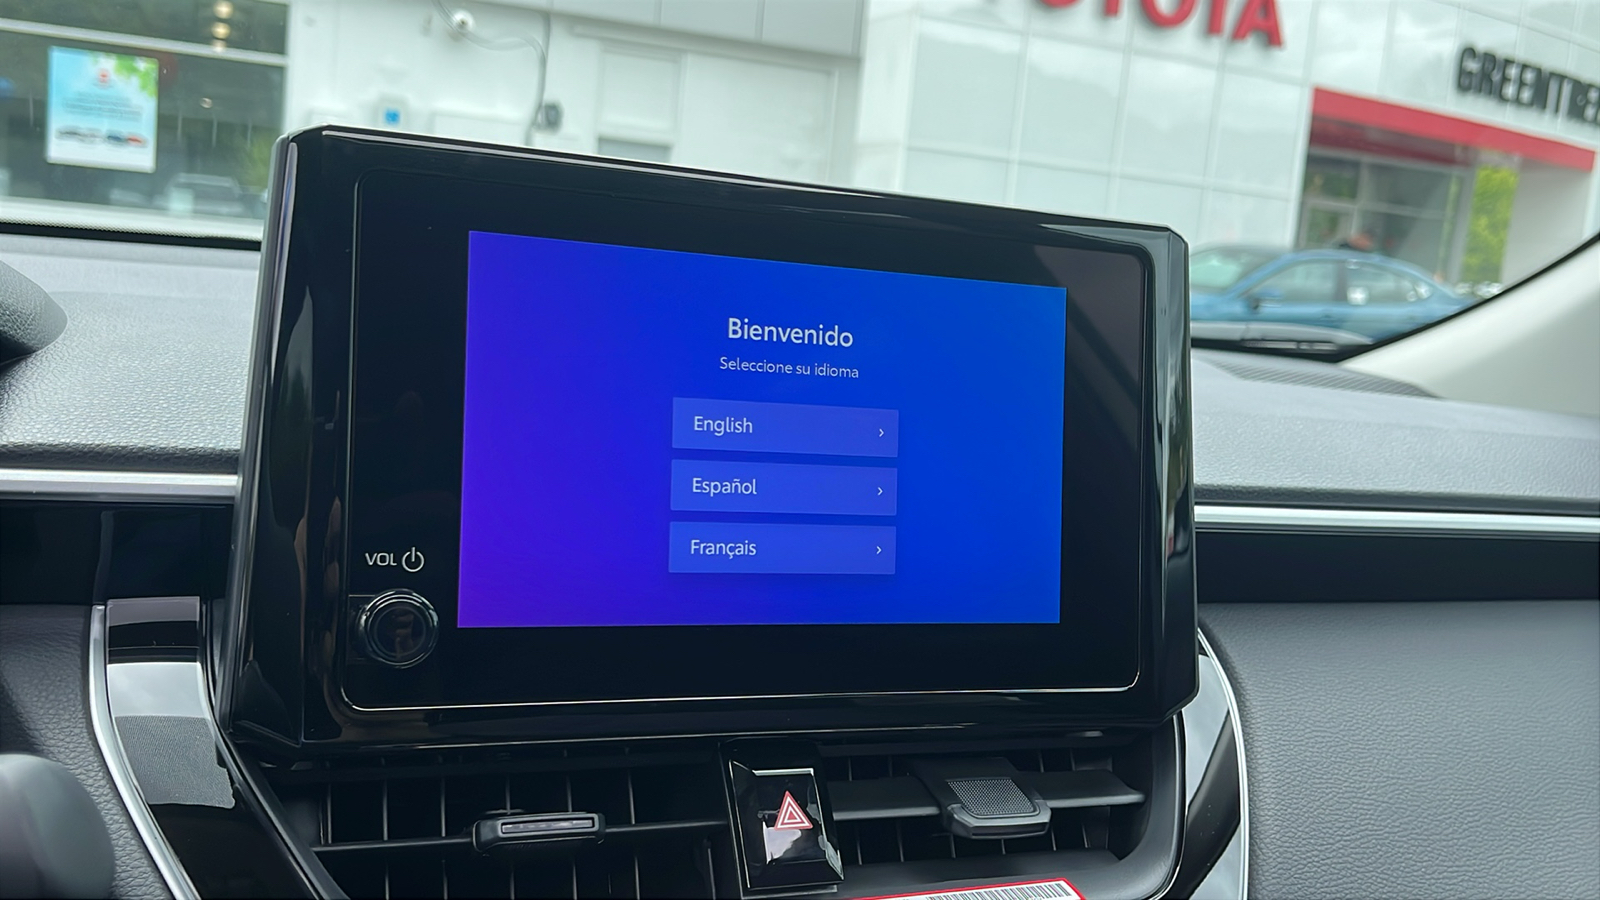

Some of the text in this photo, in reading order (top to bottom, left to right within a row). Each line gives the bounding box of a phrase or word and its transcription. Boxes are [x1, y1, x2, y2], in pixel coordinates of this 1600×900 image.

[728, 317, 854, 348] Bienvenido
[719, 356, 859, 379] Seleccione su idioma
[693, 415, 753, 437] English
[692, 477, 757, 497] Español
[364, 552, 398, 566] VOL
[690, 539, 757, 560] Français
